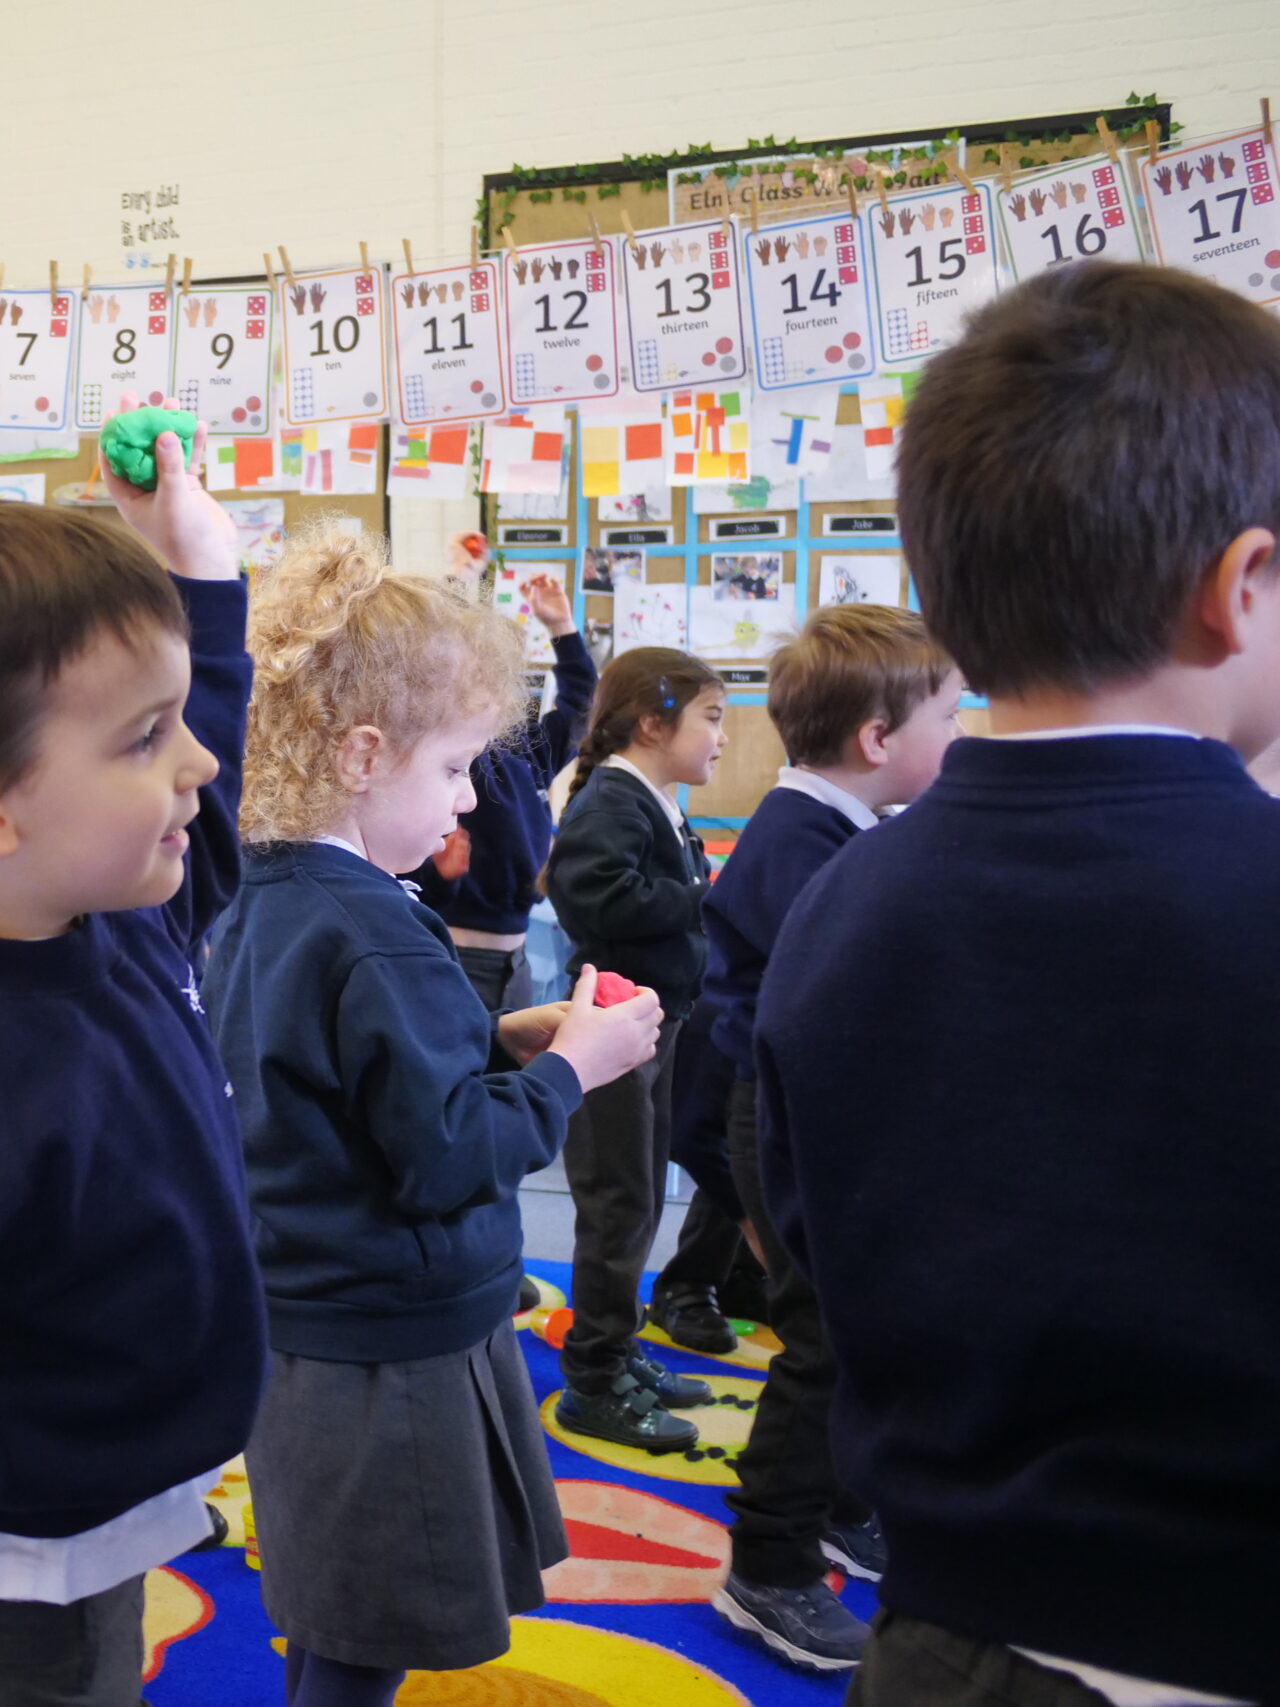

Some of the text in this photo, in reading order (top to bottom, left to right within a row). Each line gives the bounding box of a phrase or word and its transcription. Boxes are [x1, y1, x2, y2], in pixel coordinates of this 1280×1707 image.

[1188, 187, 1248, 243] 17
[1040, 213, 1107, 267] 16
[1192, 236, 1261, 263] seventeen
[904, 237, 967, 287] 15
[655, 272, 712, 318] 13
[781, 268, 842, 314] 14
[916, 286, 958, 306] fifteen
[534, 290, 589, 333] 12
[661, 319, 709, 335] thirteen
[785, 315, 838, 335] fourteen
[16, 333, 38, 366] 7
[112, 329, 137, 364] 8
[309, 315, 360, 357] 10
[423, 312, 474, 355] 11
[543, 336, 580, 350] twelve
[210, 333, 234, 370] 9
[325, 360, 342, 371] ten
[431, 357, 466, 371] eleven
[9, 372, 36, 381] seven
[111, 369, 136, 383] eight
[209, 376, 232, 386] nine
